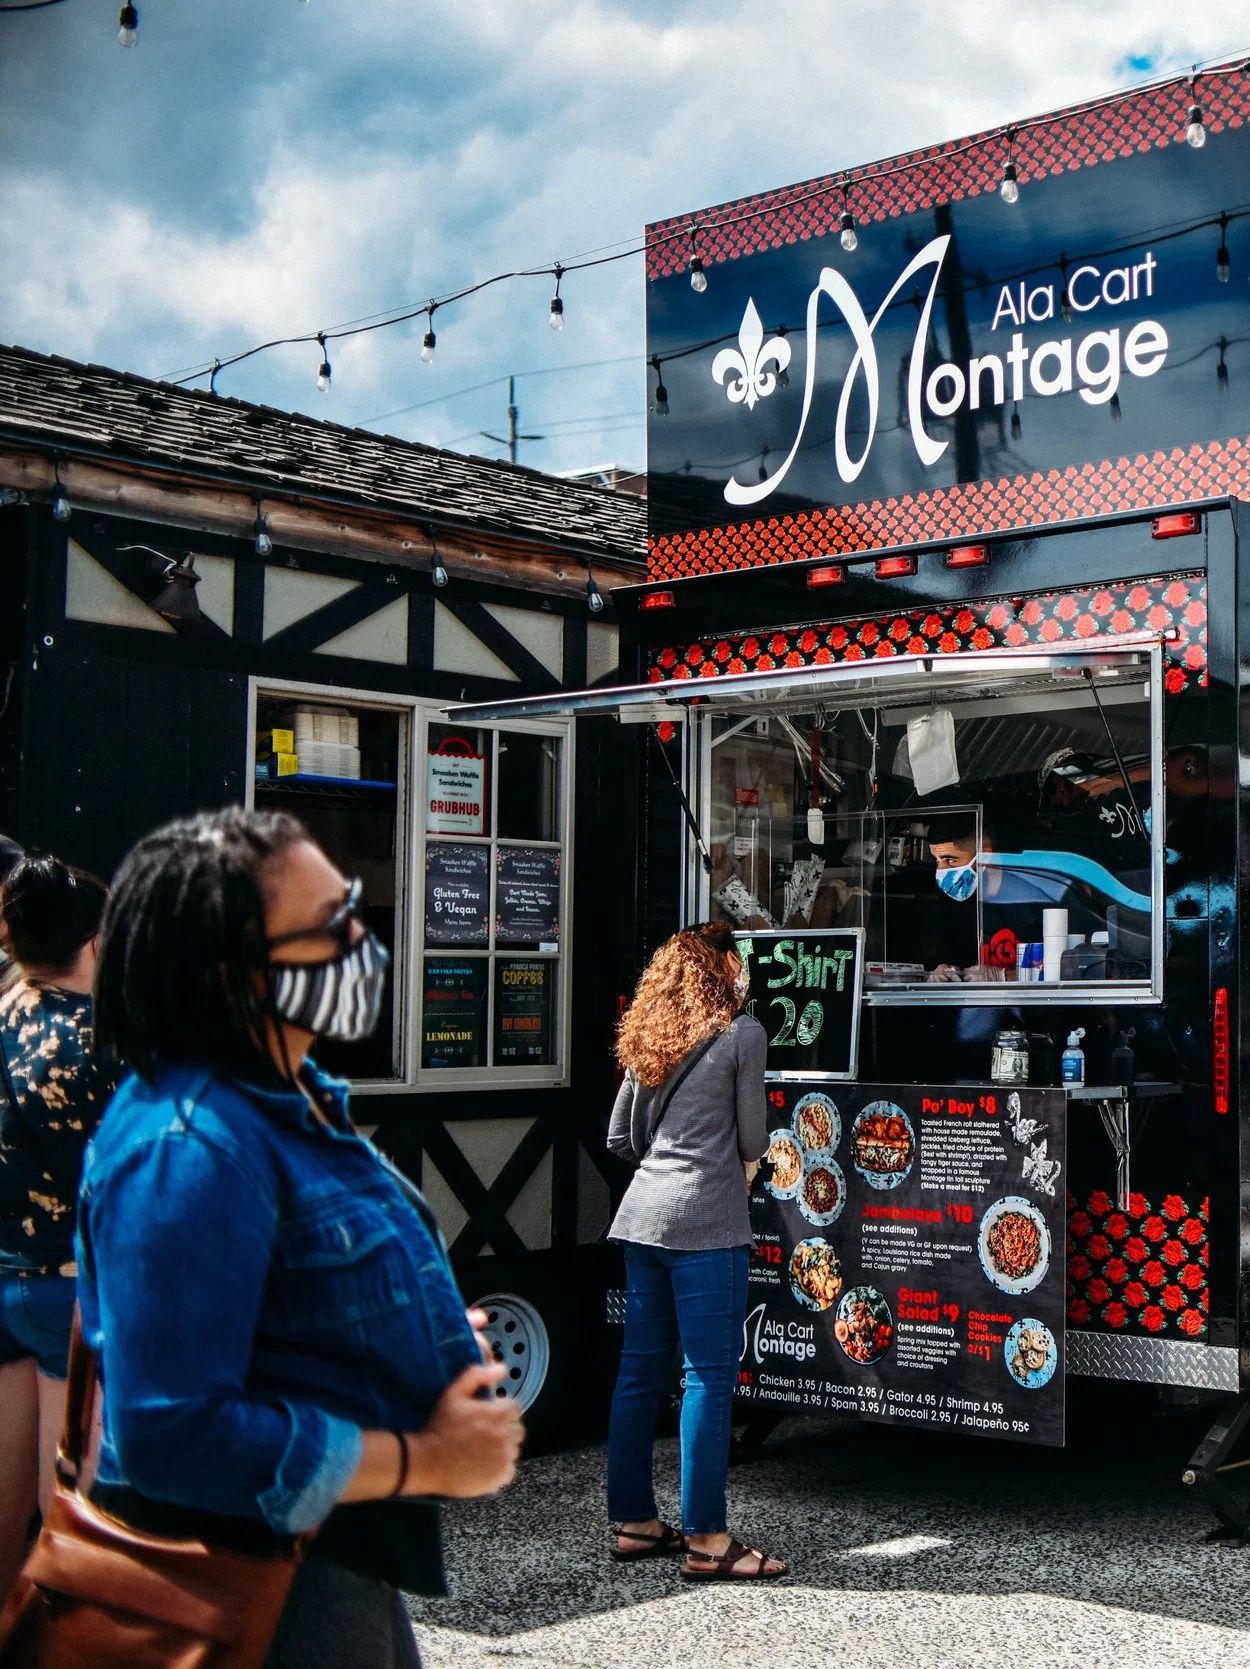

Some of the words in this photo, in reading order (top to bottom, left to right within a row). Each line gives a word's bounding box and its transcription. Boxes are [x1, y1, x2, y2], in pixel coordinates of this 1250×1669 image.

[992, 282, 1054, 331] Ala
[1068, 252, 1156, 312] Cart
[724, 234, 1168, 505] Montage
[432, 769, 458, 777] Smaaken
[460, 771, 479, 779] Waffle
[439, 779, 472, 787] Sandwiches
[430, 800, 479, 816] GRUBHUB
[434, 888, 459, 900] Gluten
[462, 889, 480, 899] Free
[445, 902, 477, 916] Vegan
[426, 1032, 472, 1040] LEMONADE
[769, 1091, 784, 1108] $5
[948, 1098, 974, 1118] Boy
[980, 1096, 996, 1114] $8
[944, 1120, 962, 1128] French
[921, 1182, 939, 1190] (Make
[863, 1204, 943, 1224] Jambalaya
[947, 1204, 973, 1224] $10
[862, 1224, 877, 1234] (see
[880, 1225, 918, 1236] additions)
[759, 1246, 781, 1263] $12
[883, 1248, 908, 1256] Louisiana
[949, 1244, 972, 1253] request)
[874, 1263, 890, 1271] Cajun
[893, 1256, 911, 1264] celery,
[912, 1258, 934, 1266] tomato,
[898, 1287, 938, 1304] Giant
[898, 1303, 939, 1321] Salad
[943, 1304, 960, 1322] $9
[968, 1311, 1013, 1323] Chocolate
[764, 1320, 784, 1335] Ala
[788, 1322, 814, 1339] Cart
[898, 1323, 914, 1332] (see
[916, 1324, 954, 1337] additions)
[968, 1321, 988, 1332] Chip
[897, 1336, 914, 1344] Spring
[927, 1339, 947, 1348] topped
[968, 1332, 1002, 1343] Cookies
[922, 1347, 944, 1355] veggies
[968, 1344, 992, 1360] 2/$1
[897, 1352, 916, 1360] choice
[925, 1355, 947, 1364] dressing
[910, 1362, 934, 1370] croutons
[759, 1374, 794, 1387] Chicken
[798, 1378, 815, 1390] 3.95
[826, 1382, 855, 1395] Bacon
[858, 1386, 876, 1398] 2.95
[887, 1389, 914, 1403] Gator
[916, 1393, 936, 1405] 4.95
[947, 1397, 980, 1413] Shrimp
[983, 1402, 1003, 1414] 4.95
[759, 1388, 800, 1402] Andouille
[804, 1394, 821, 1405] 3.95
[832, 1398, 857, 1410] Spam
[860, 1401, 879, 1412] 3.95
[889, 1404, 928, 1420] Broccoli
[931, 1410, 950, 1422] 2.95
[961, 1415, 1009, 1430] Jalapeño
[1012, 1421, 1029, 1432] 95¢
